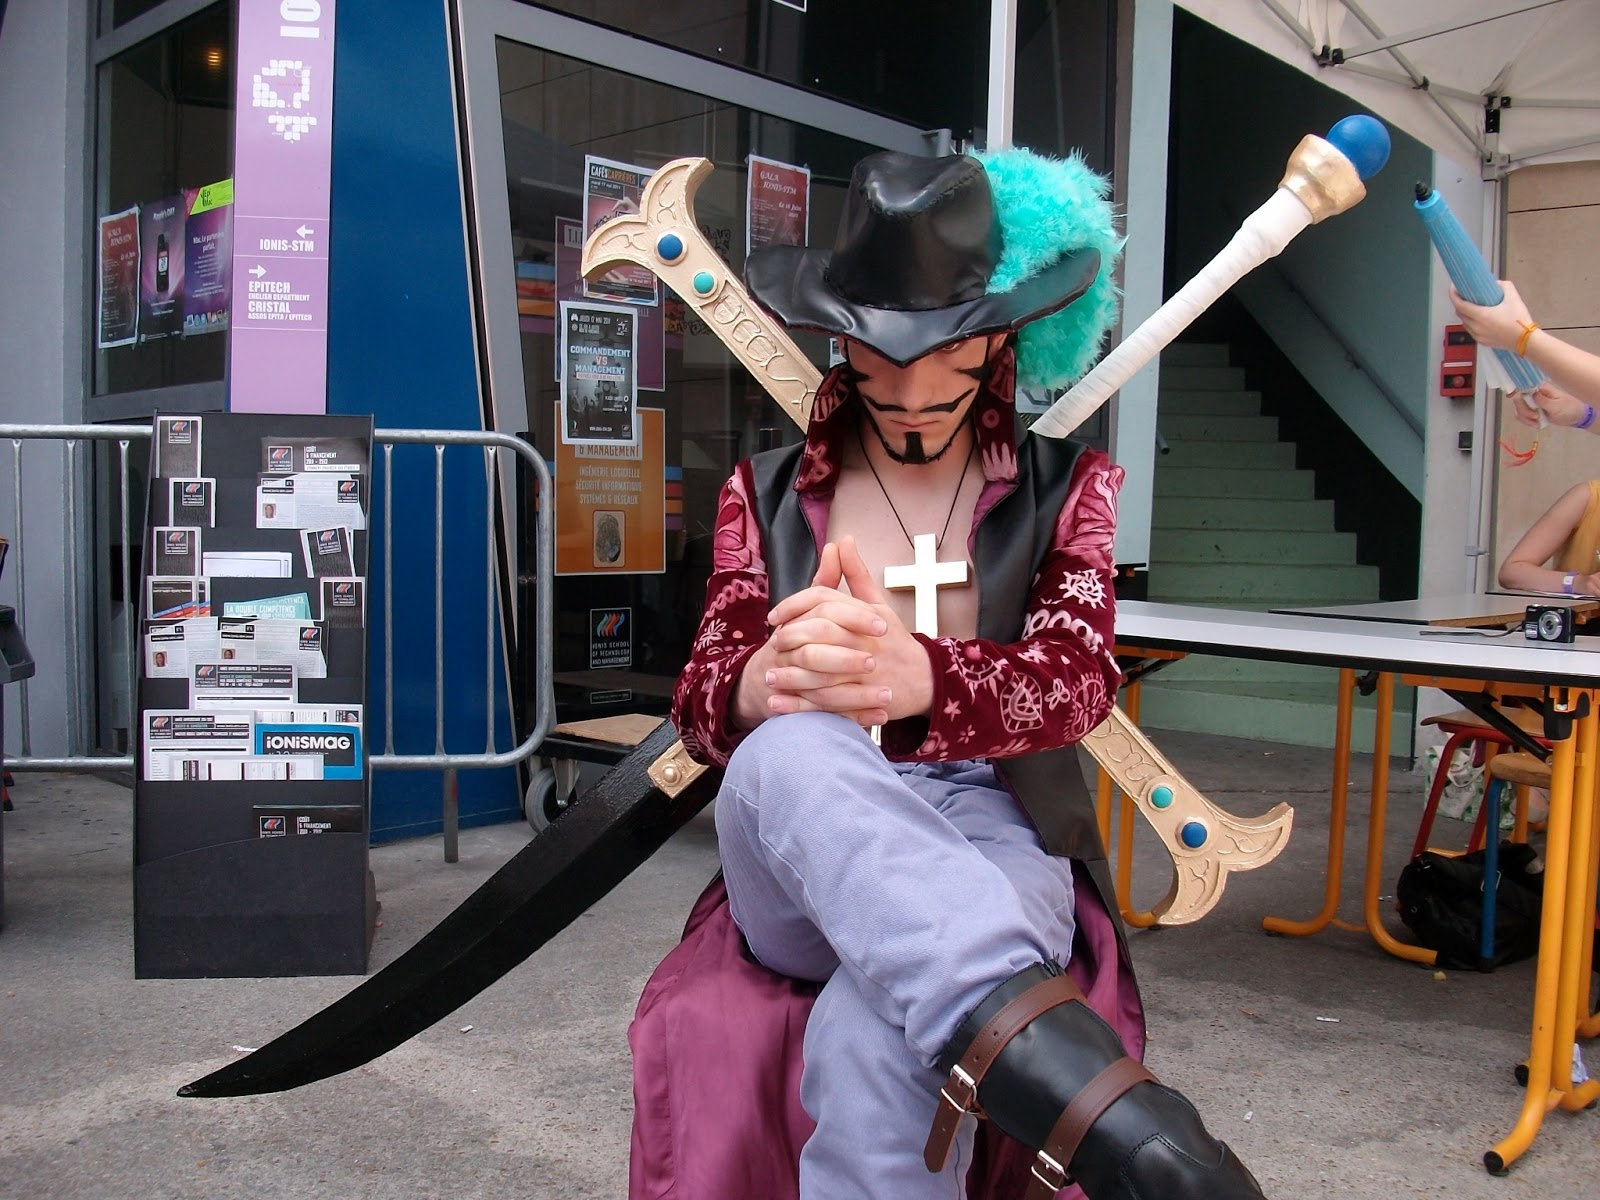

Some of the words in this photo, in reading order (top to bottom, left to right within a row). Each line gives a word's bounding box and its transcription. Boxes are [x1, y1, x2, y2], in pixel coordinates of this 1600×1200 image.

[759, 170, 779, 182] GALA
[763, 181, 797, 195] IONIS-STM
[259, 238, 315, 253] IONIS-STM
[248, 280, 291, 294] EPITECH
[248, 292, 272, 300] ENGLISH
[272, 293, 311, 302] DEPARTMENT
[248, 300, 291, 314] CRISTAL
[247, 312, 268, 320] ASSOS
[267, 313, 284, 321] EPITA
[288, 313, 313, 321] EPITECH
[570, 345, 631, 358] COMMANDEMENT
[595, 355, 608, 366] VS
[575, 363, 626, 375] MANAGEMENT
[587, 444, 640, 457] MANAGEMENT
[226, 605, 234, 613] LA
[235, 605, 257, 613] DOUBLE
[260, 604, 296, 614] COMPÉTENCE
